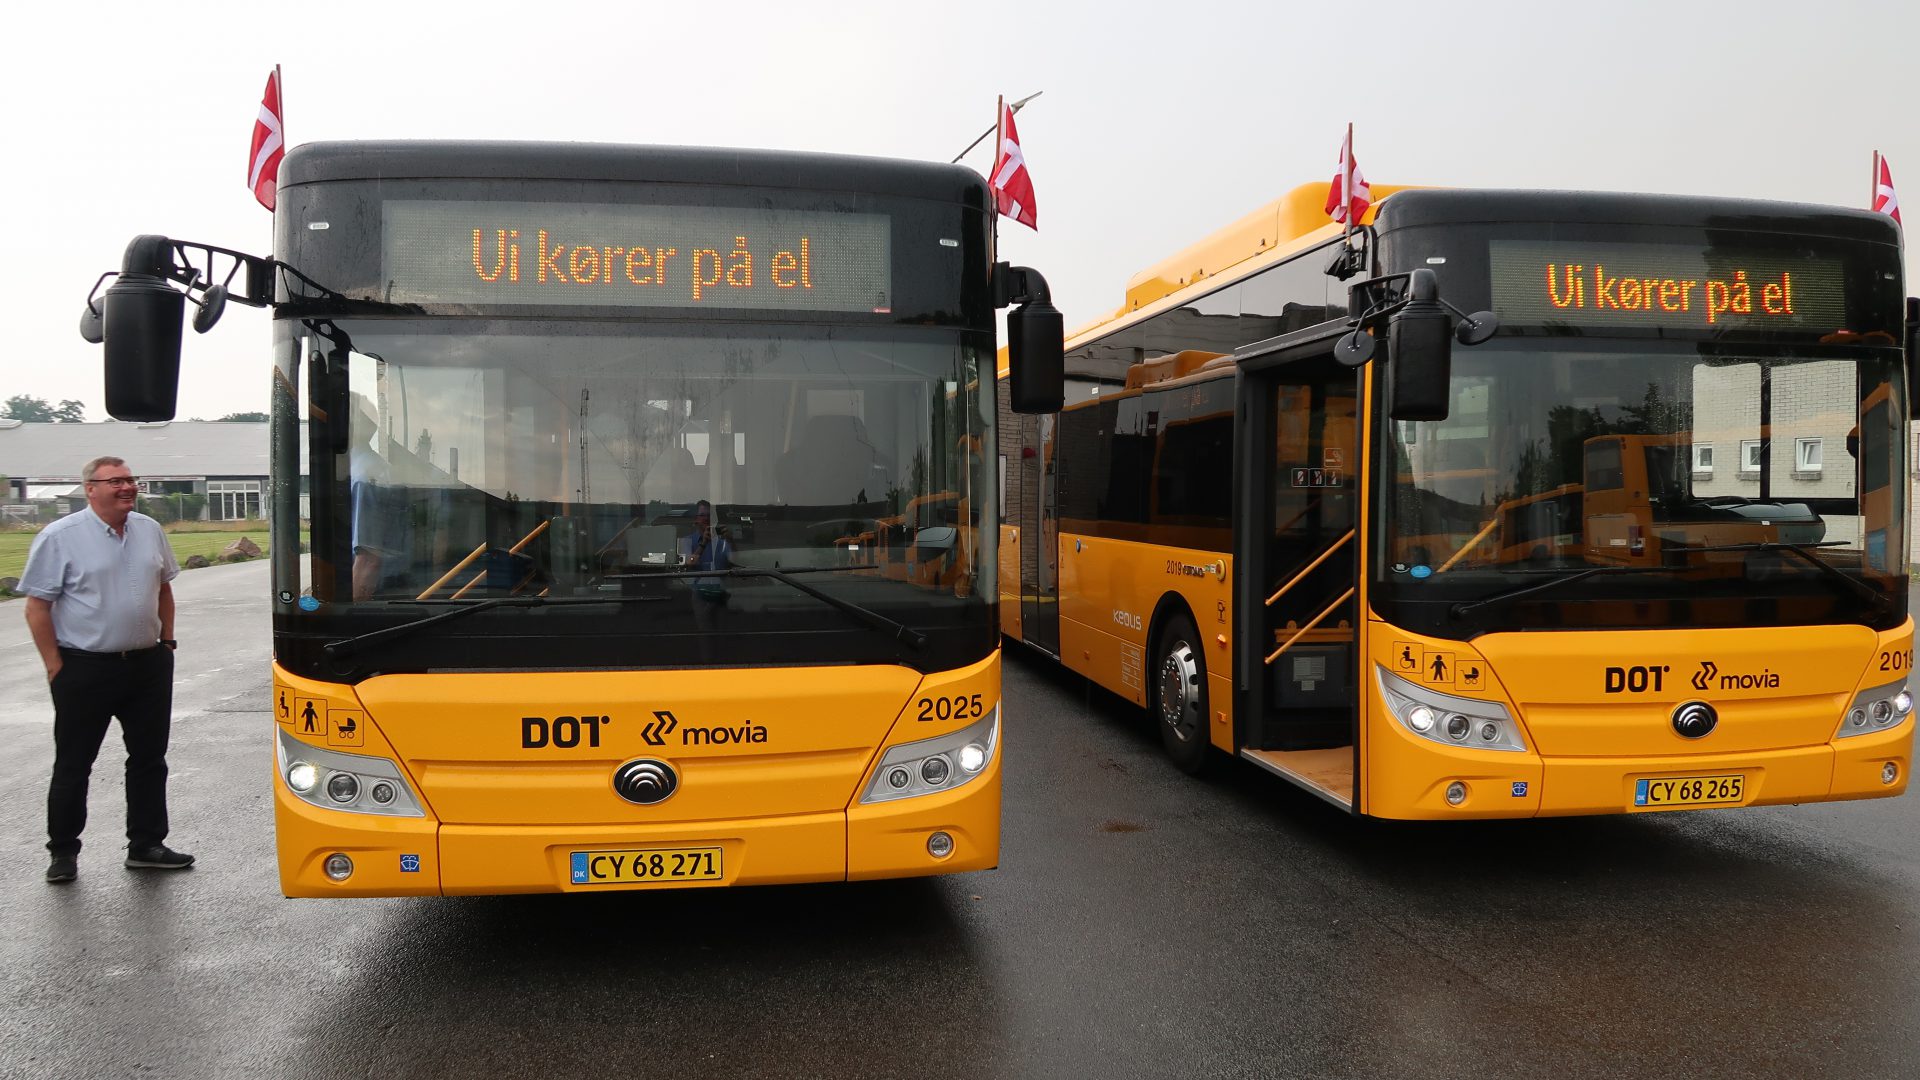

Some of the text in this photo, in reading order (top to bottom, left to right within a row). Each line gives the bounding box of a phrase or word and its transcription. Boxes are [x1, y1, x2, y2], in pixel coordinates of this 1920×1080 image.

[537, 228, 677, 284] kører
[692, 236, 753, 300] på
[771, 238, 813, 288] el
[1595, 263, 1697, 313] kører
[1706, 270, 1752, 324] på
[1761, 271, 1794, 314] el
[1880, 649, 1914, 671] 2019
[1605, 665, 1671, 693] DOT
[1720, 669, 1780, 690] movia
[918, 694, 983, 721] 2025
[521, 715, 610, 748] DOT
[682, 720, 768, 746] movia
[1650, 779, 1741, 801] CY 68 265
[574, 870, 585, 878] DK
[590, 852, 716, 879] CY 68 271
